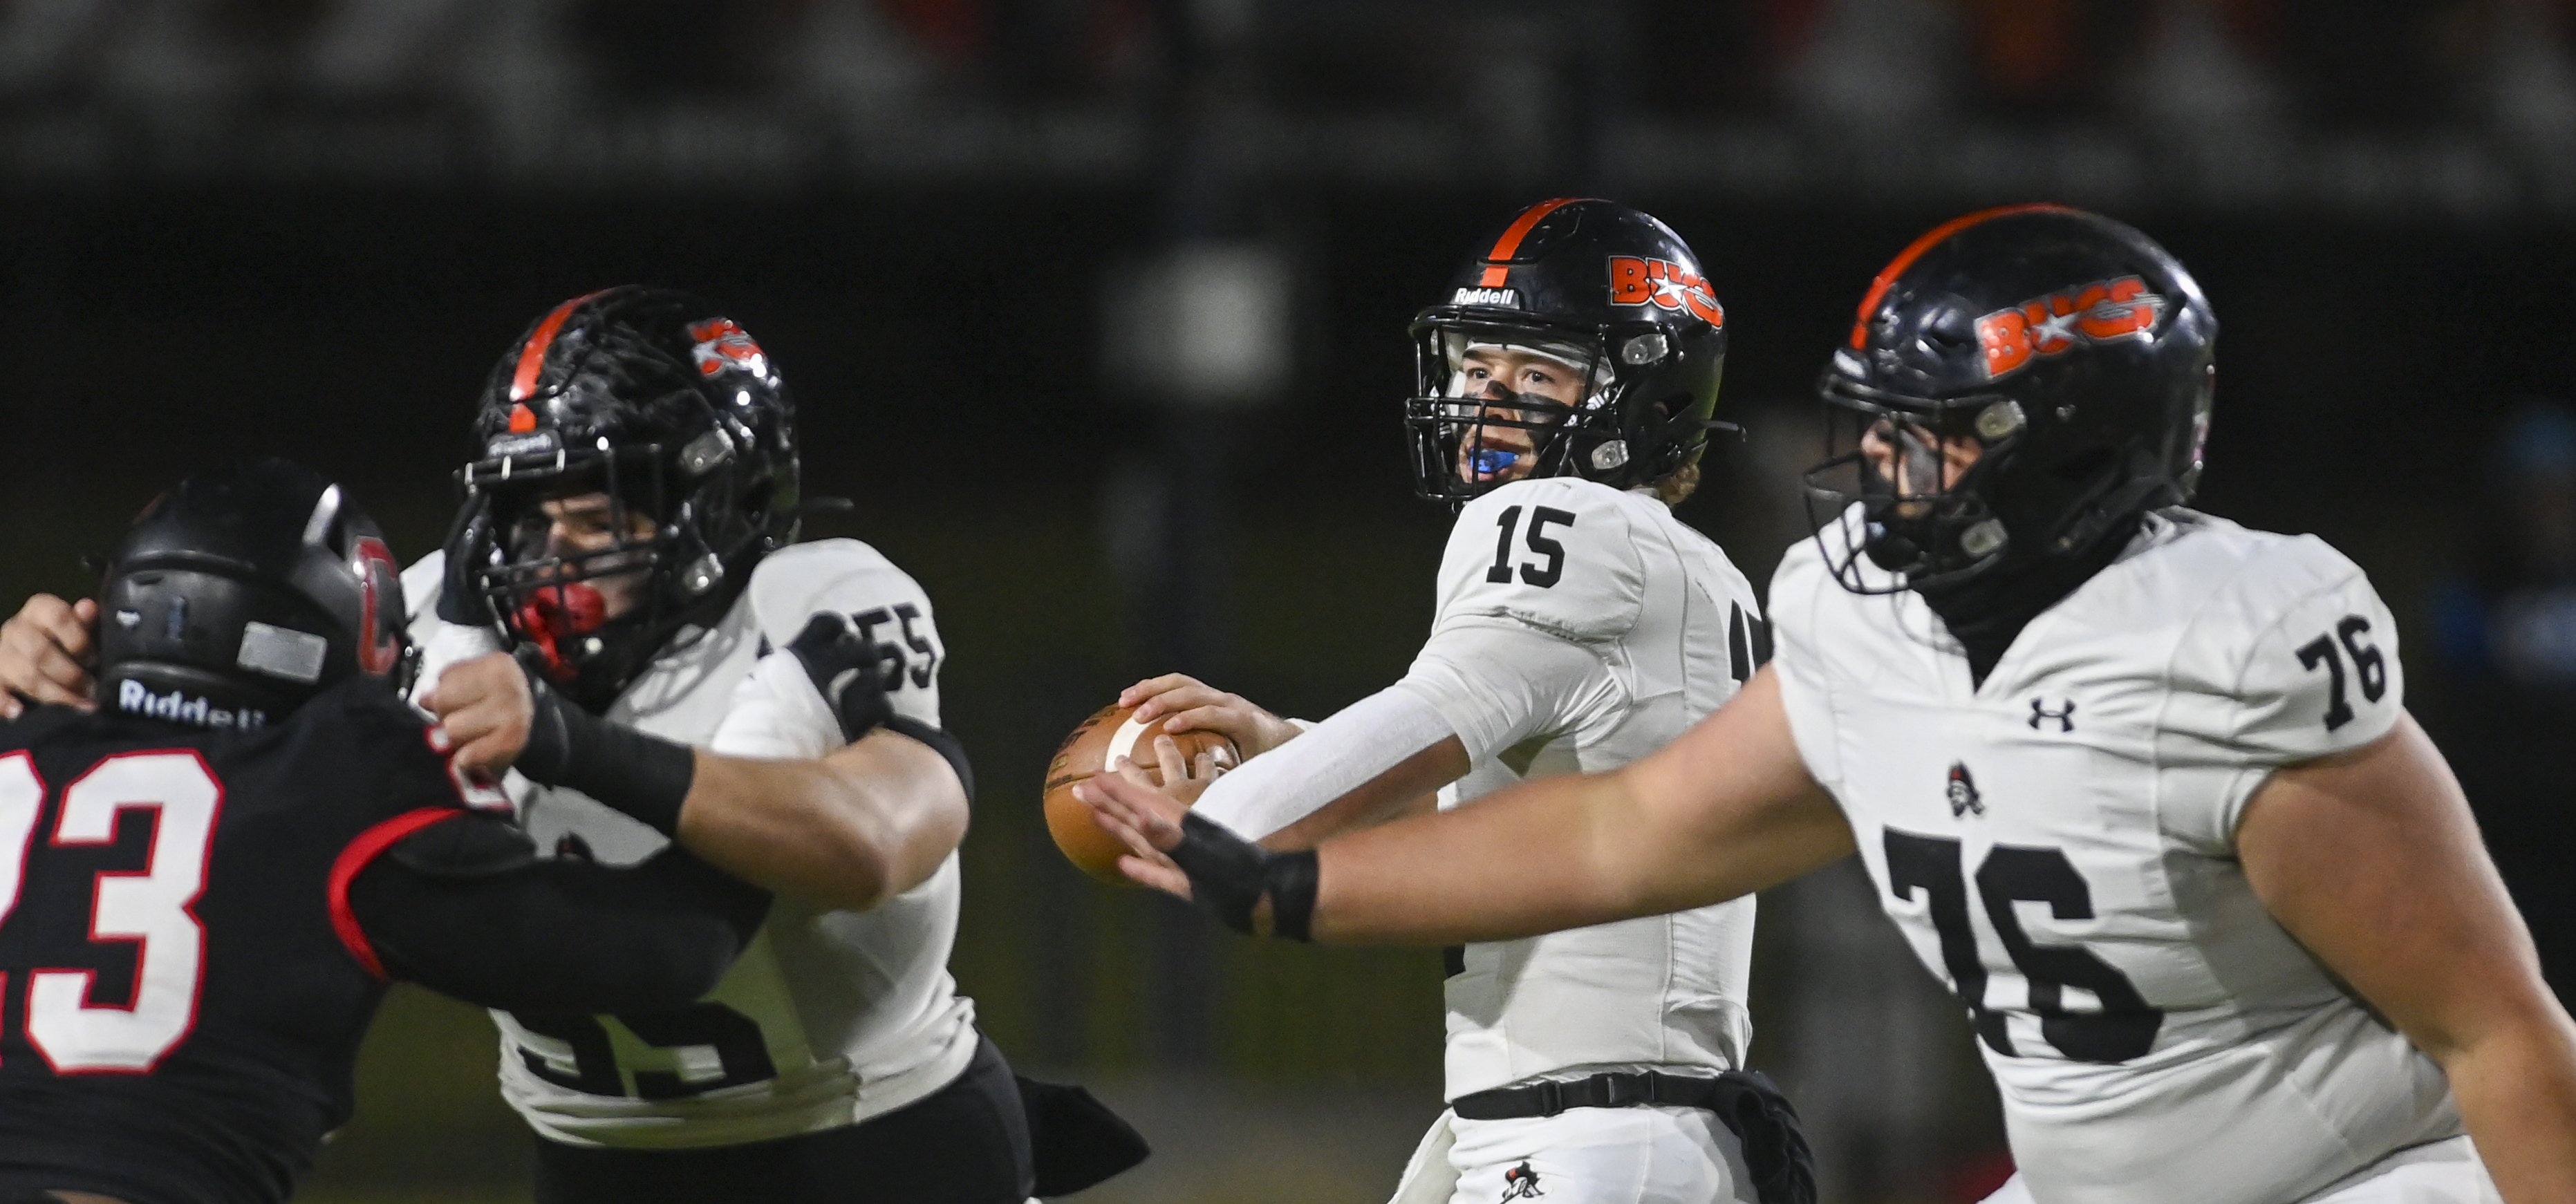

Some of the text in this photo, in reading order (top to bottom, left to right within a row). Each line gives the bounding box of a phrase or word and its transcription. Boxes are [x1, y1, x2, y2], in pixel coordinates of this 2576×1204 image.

[1455, 288, 1515, 304] Riddell
[1486, 505, 1576, 589] 15
[850, 601, 936, 690] 55
[2296, 613, 2387, 733] 76
[0, 749, 225, 1075] 3
[1883, 824, 2163, 1063] 76
